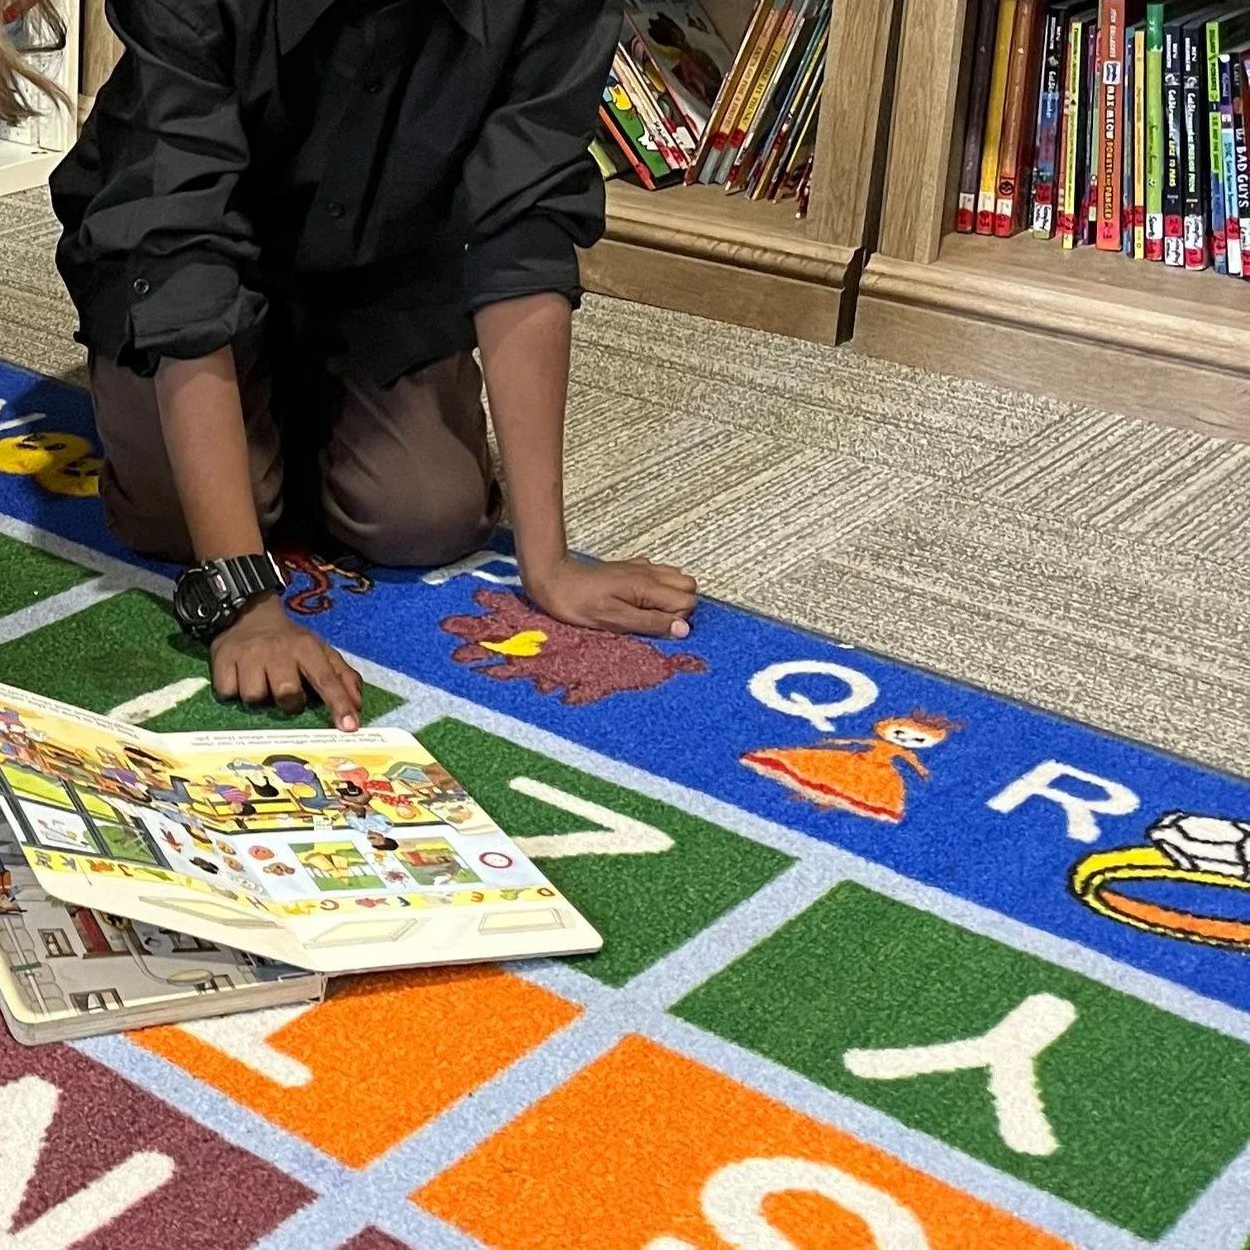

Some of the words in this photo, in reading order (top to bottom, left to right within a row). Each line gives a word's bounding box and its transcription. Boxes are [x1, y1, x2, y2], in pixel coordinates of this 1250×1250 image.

[760, 53, 777, 80] BROKE
[738, 80, 749, 95] FOR
[754, 82, 764, 94] MY
[1106, 85, 1114, 106] MAX
[1105, 109, 1114, 140] MEOW
[1187, 143, 1196, 171] MISSION
[1236, 146, 1247, 171] BAD
[1168, 168, 1176, 186] MARS
[1188, 173, 1196, 192] MOON
[1236, 174, 1250, 207] GUYS
[1103, 186, 1112, 220] DANGER
[747, 659, 880, 732] Q
[986, 759, 1141, 844] R
[843, 992, 1077, 1157] Y
